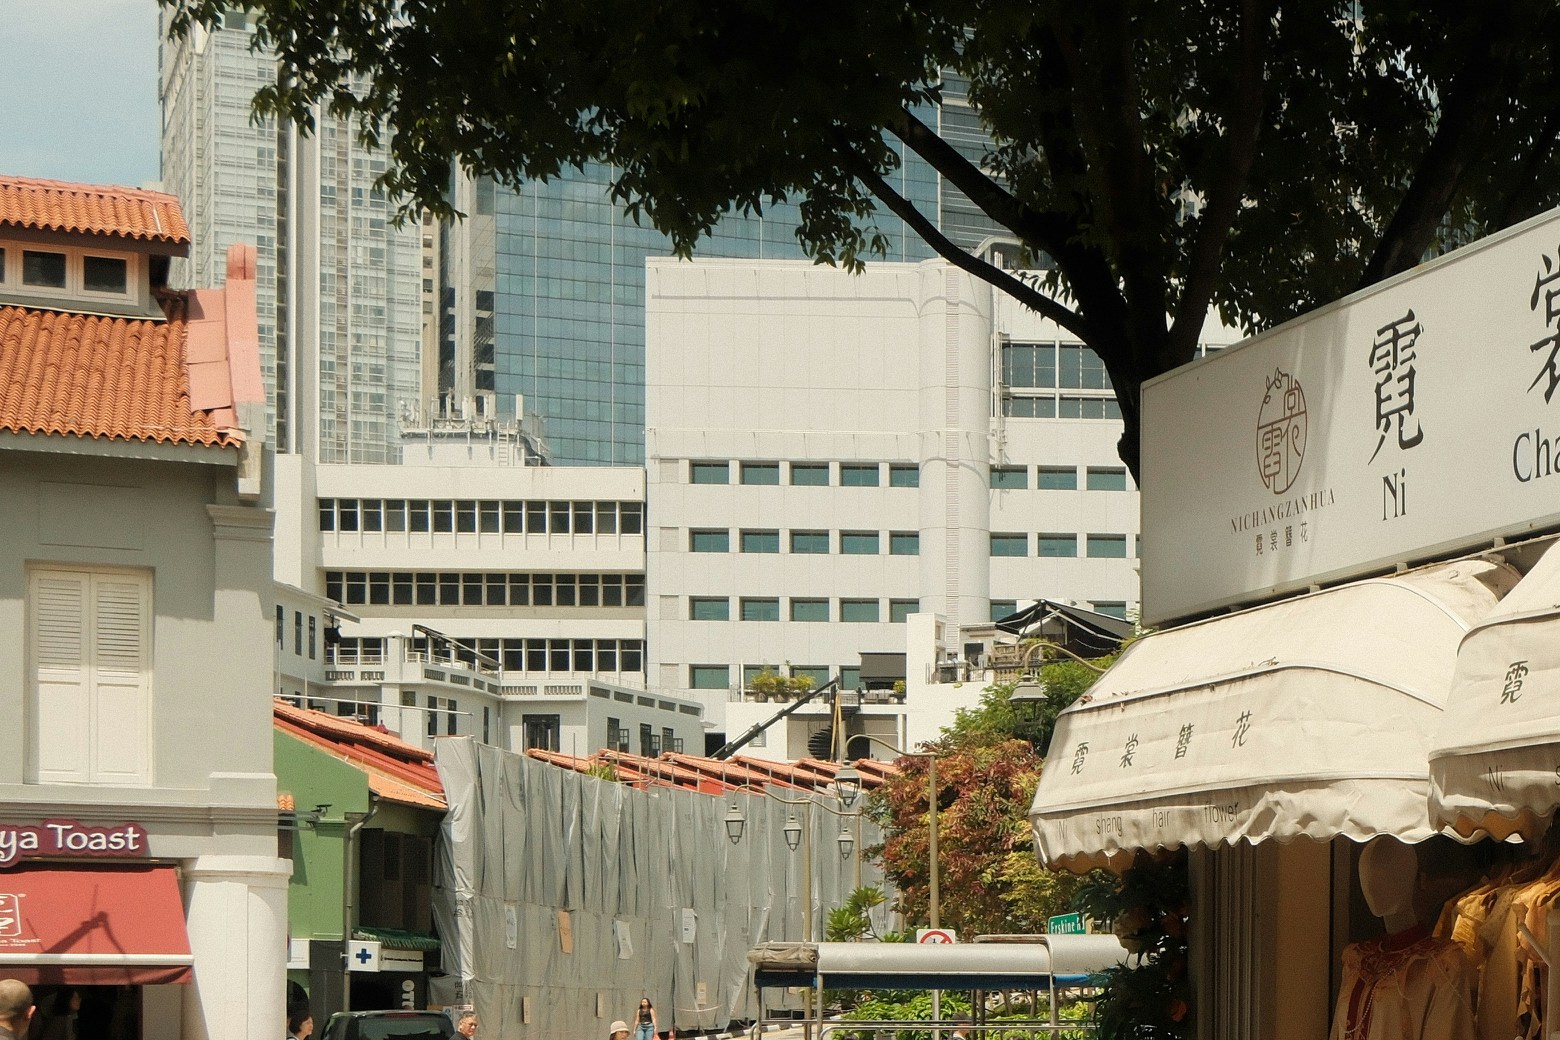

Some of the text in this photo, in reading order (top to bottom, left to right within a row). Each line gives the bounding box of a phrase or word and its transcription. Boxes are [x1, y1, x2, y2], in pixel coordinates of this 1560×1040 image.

[1382, 467, 1407, 522] Ni
[1230, 487, 1336, 535] NICHANGZANHUA
[1488, 764, 1504, 792] Ni
[1096, 815, 1123, 837] shang
[1152, 809, 1170, 828] hair
[1203, 800, 1239, 824] flower
[47, 824, 140, 850] Toast
[1050, 919, 1075, 934] Erskine
